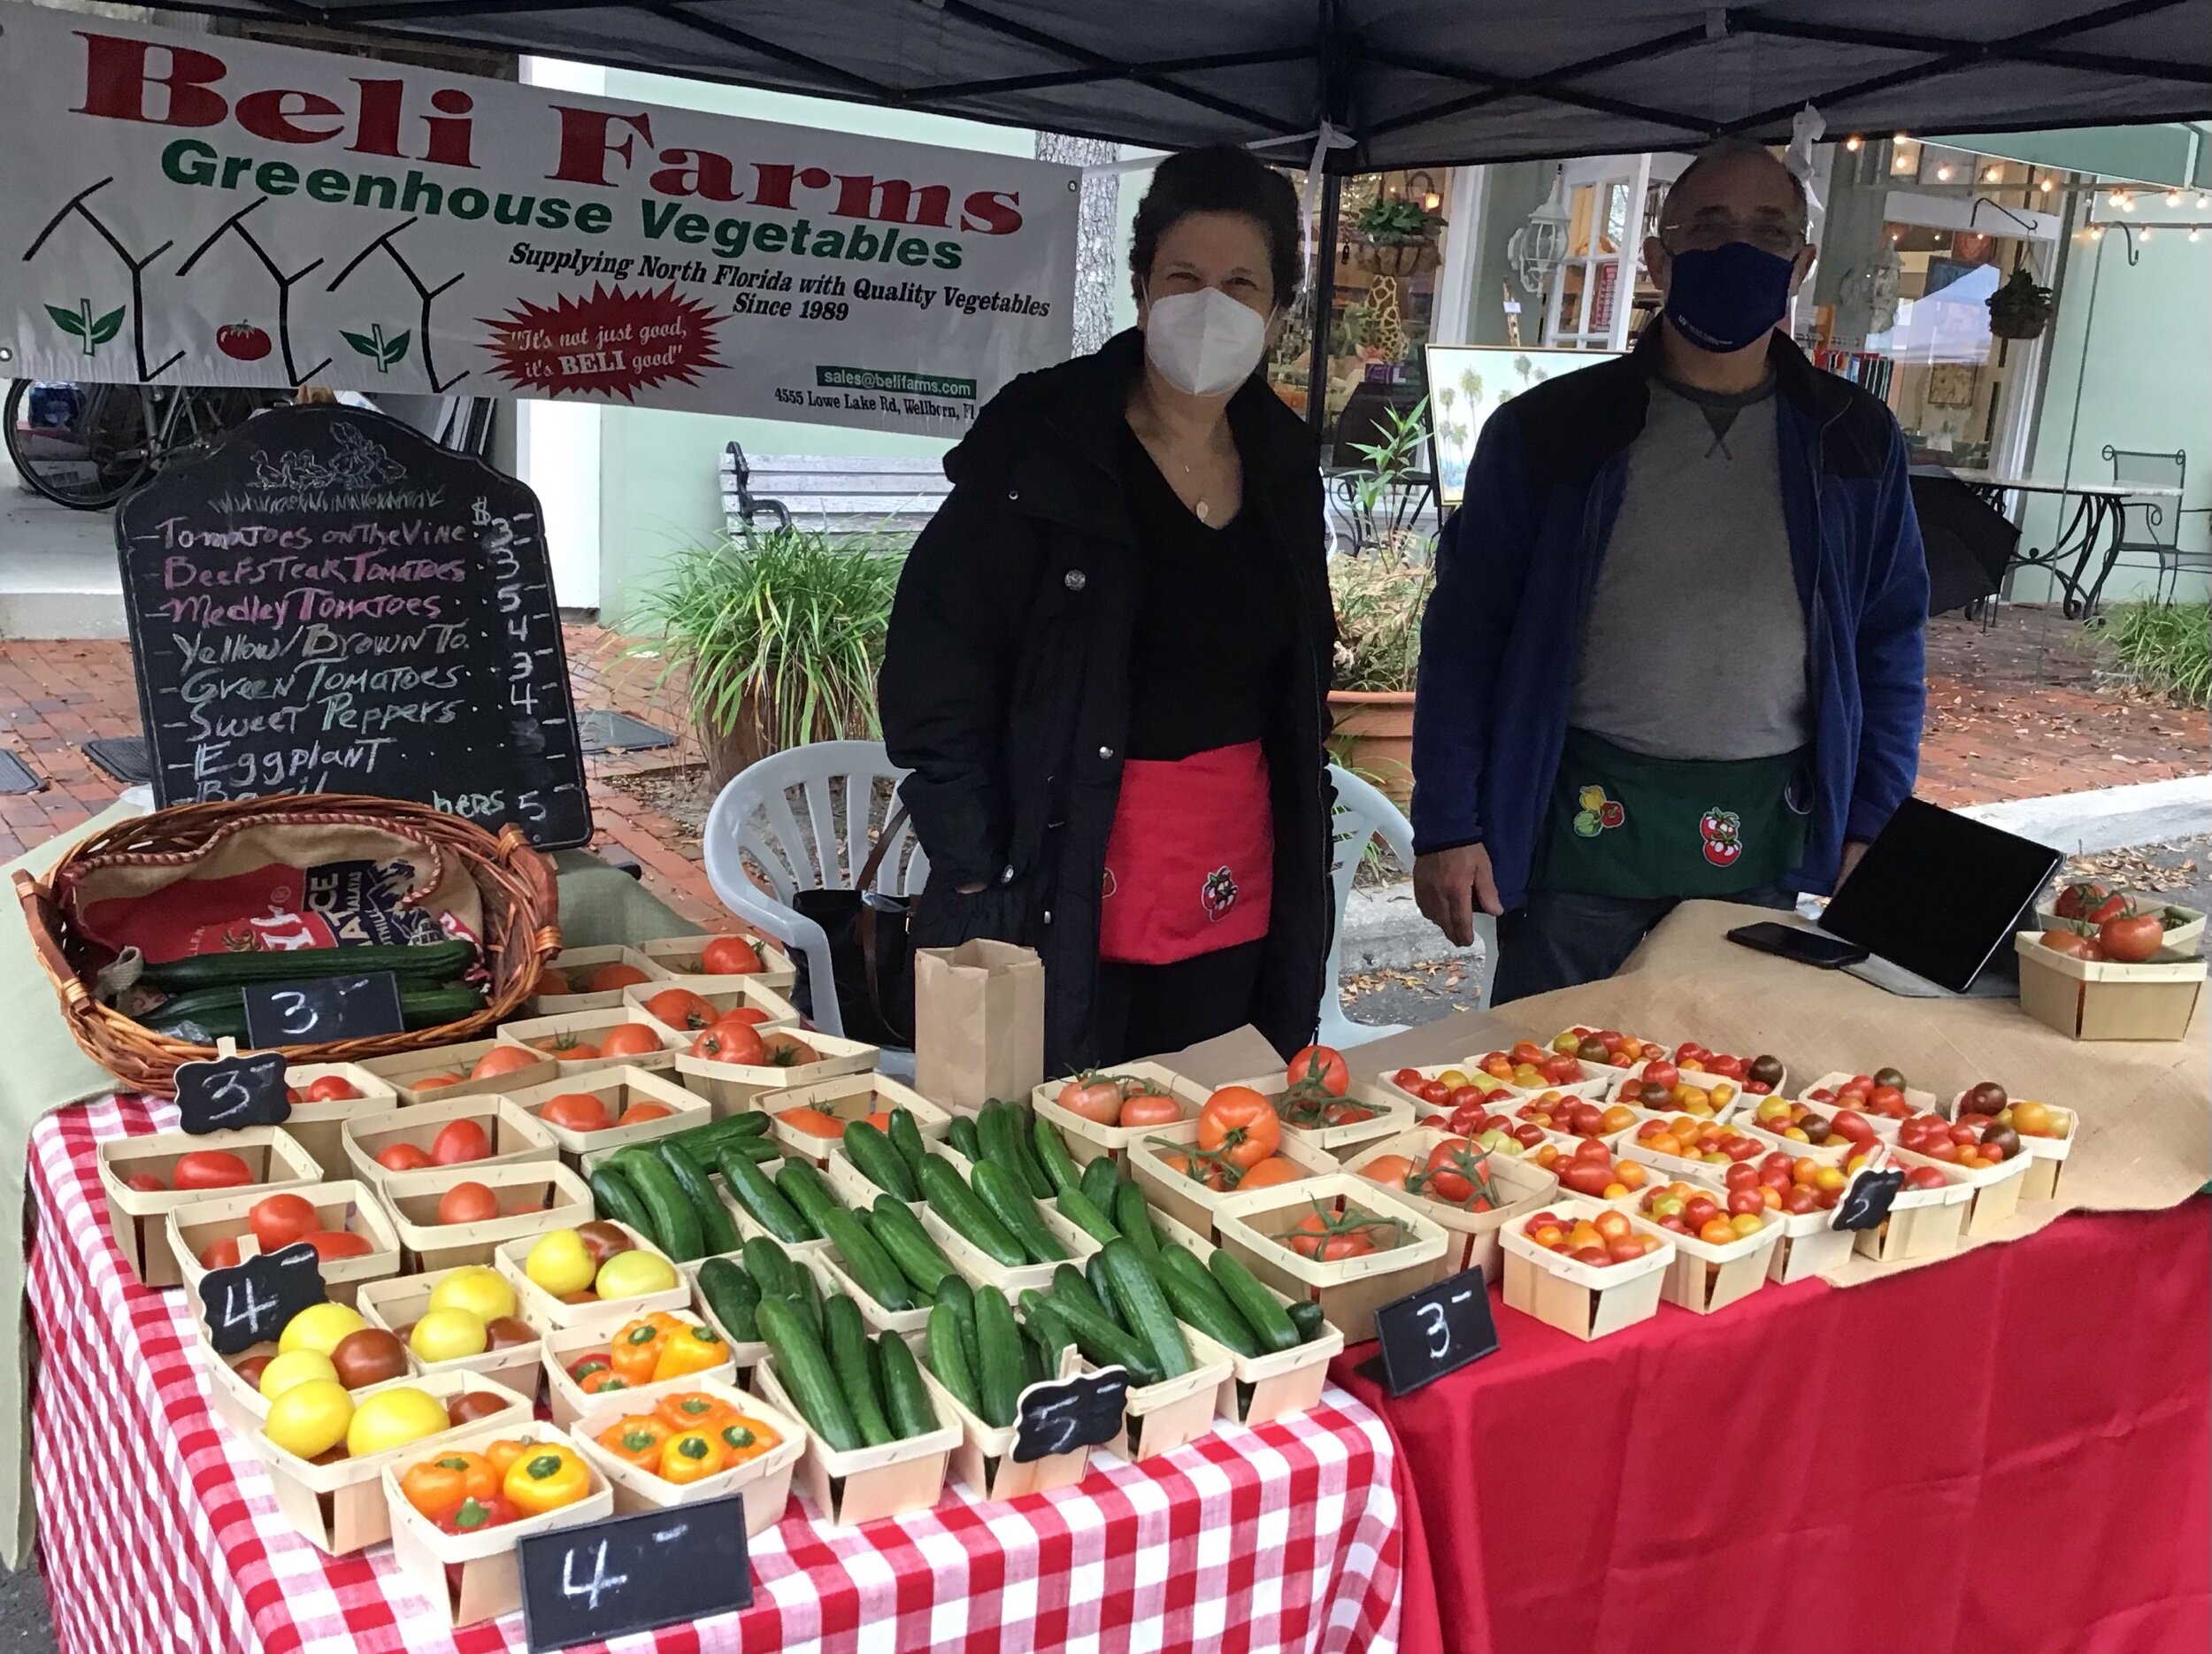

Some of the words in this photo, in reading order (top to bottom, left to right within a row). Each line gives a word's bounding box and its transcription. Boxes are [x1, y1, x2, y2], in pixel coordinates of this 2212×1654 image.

[67, 31, 480, 169] Beli
[544, 104, 1024, 235] Farms
[161, 139, 613, 234] Greenhouse
[641, 198, 964, 270] Vegetables
[509, 242, 634, 281] Supplying
[637, 255, 707, 284] North
[712, 265, 793, 294] Florida
[798, 275, 849, 297] with
[853, 278, 937, 310] Quality
[942, 286, 1051, 318] Vegetables
[733, 292, 792, 319] Since
[798, 299, 849, 322] 1989
[559, 327, 589, 347] not
[595, 323, 634, 350] just
[639, 315, 687, 345] good,
[525, 358, 554, 378] it's
[557, 350, 626, 375] BELI
[632, 344, 683, 374] good"
[824, 368, 972, 396] sales@belifarms.com
[774, 388, 804, 406] 4555
[807, 390, 841, 409] Lowe
[843, 393, 877, 411] Lake
[879, 395, 902, 415] Rd,
[903, 398, 960, 420] Wellborn,
[159, 594, 289, 630] Medley
